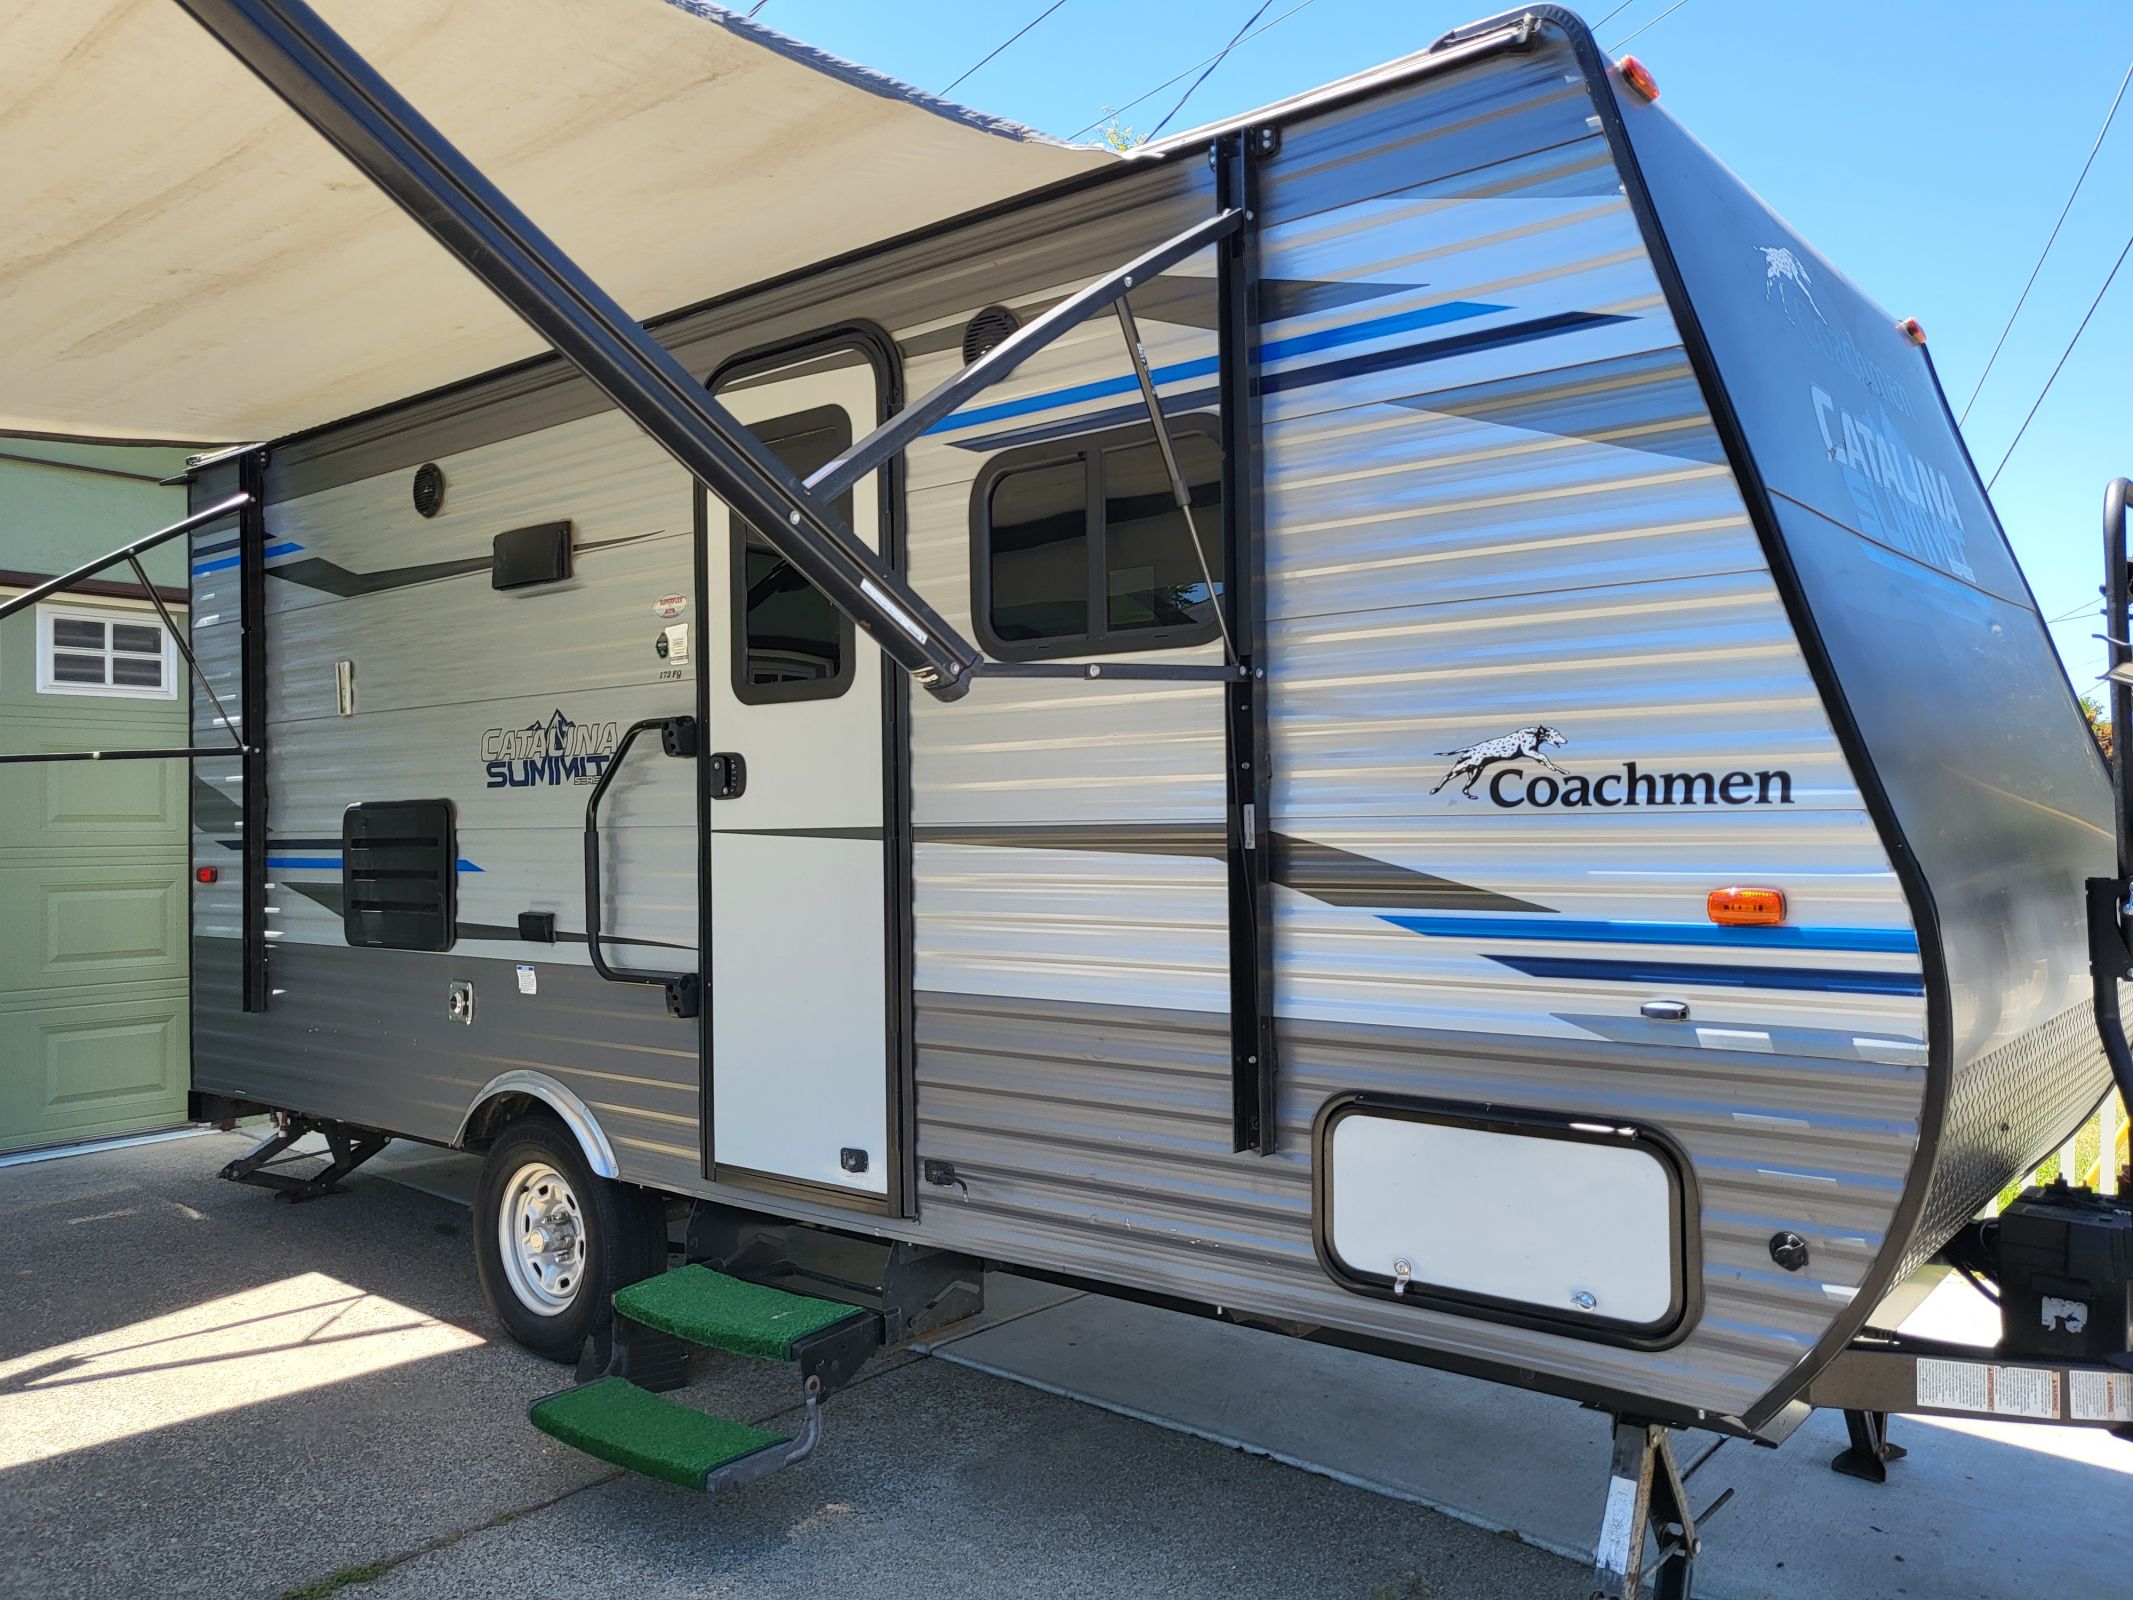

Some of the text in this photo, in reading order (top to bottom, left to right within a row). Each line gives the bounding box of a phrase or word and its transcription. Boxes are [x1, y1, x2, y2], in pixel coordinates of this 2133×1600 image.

[1791, 294, 1918, 423] Coachmen
[1810, 382, 1966, 534] CATALINA
[659, 670, 672, 680] 172
[480, 721, 620, 763] CATALINA
[486, 755, 610, 788] SUMMIT
[1489, 761, 1795, 809] Coachmen
